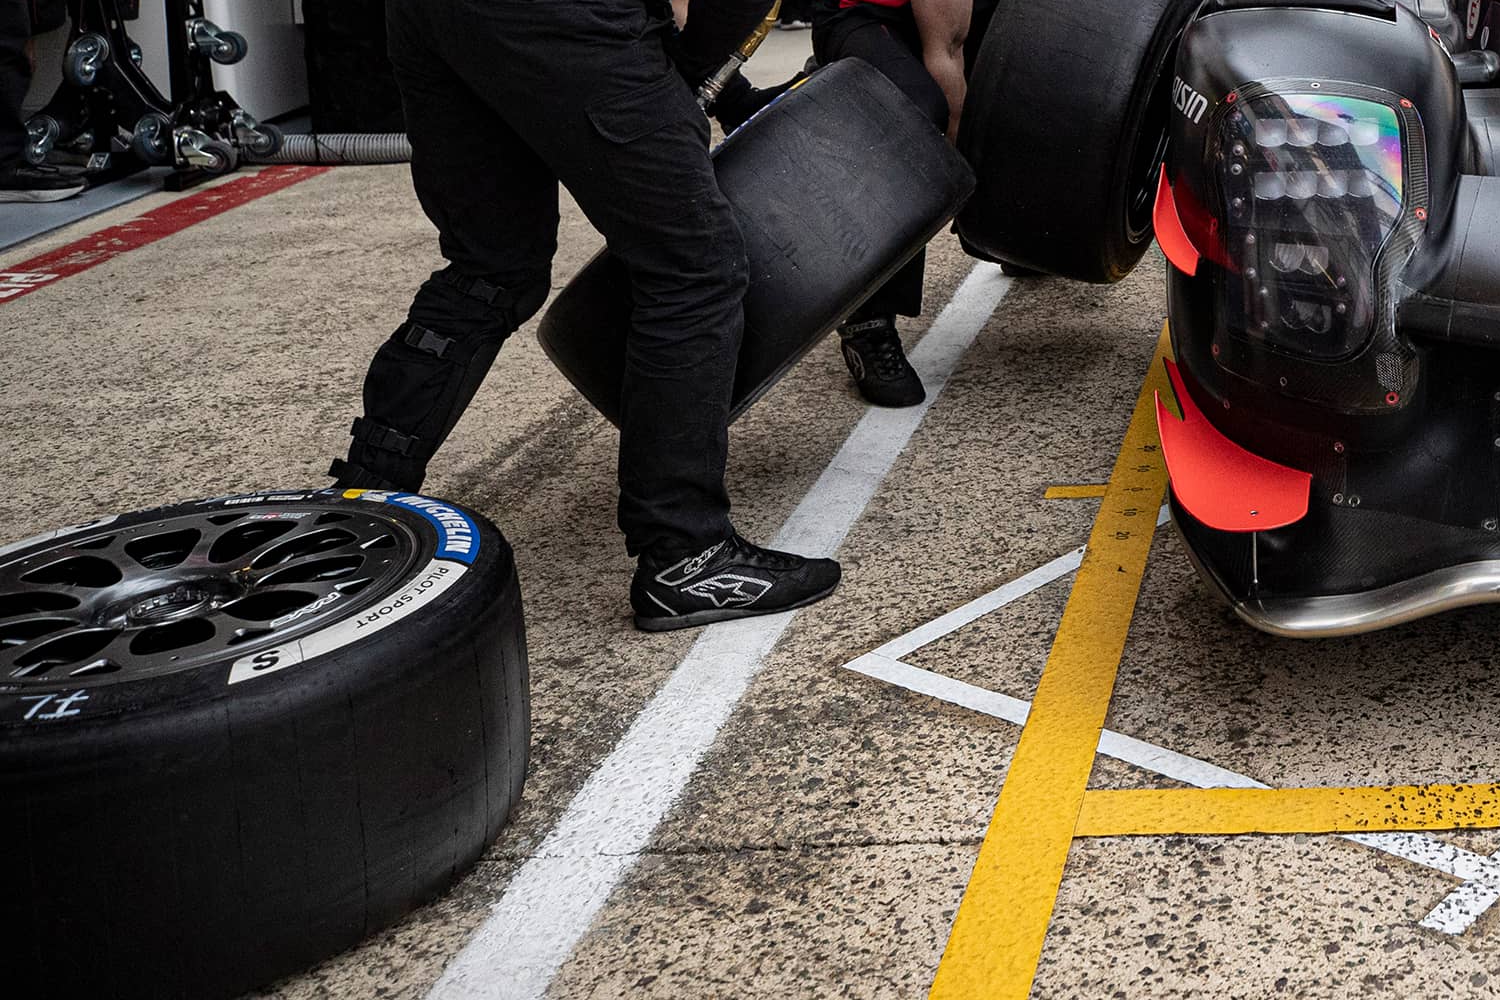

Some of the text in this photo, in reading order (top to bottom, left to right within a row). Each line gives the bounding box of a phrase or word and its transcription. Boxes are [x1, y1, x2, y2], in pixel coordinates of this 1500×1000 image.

[393, 495, 473, 554] MICHELIN
[414, 567, 450, 595] PILOT
[356, 594, 414, 628] SPORT
[251, 650, 280, 671] S
